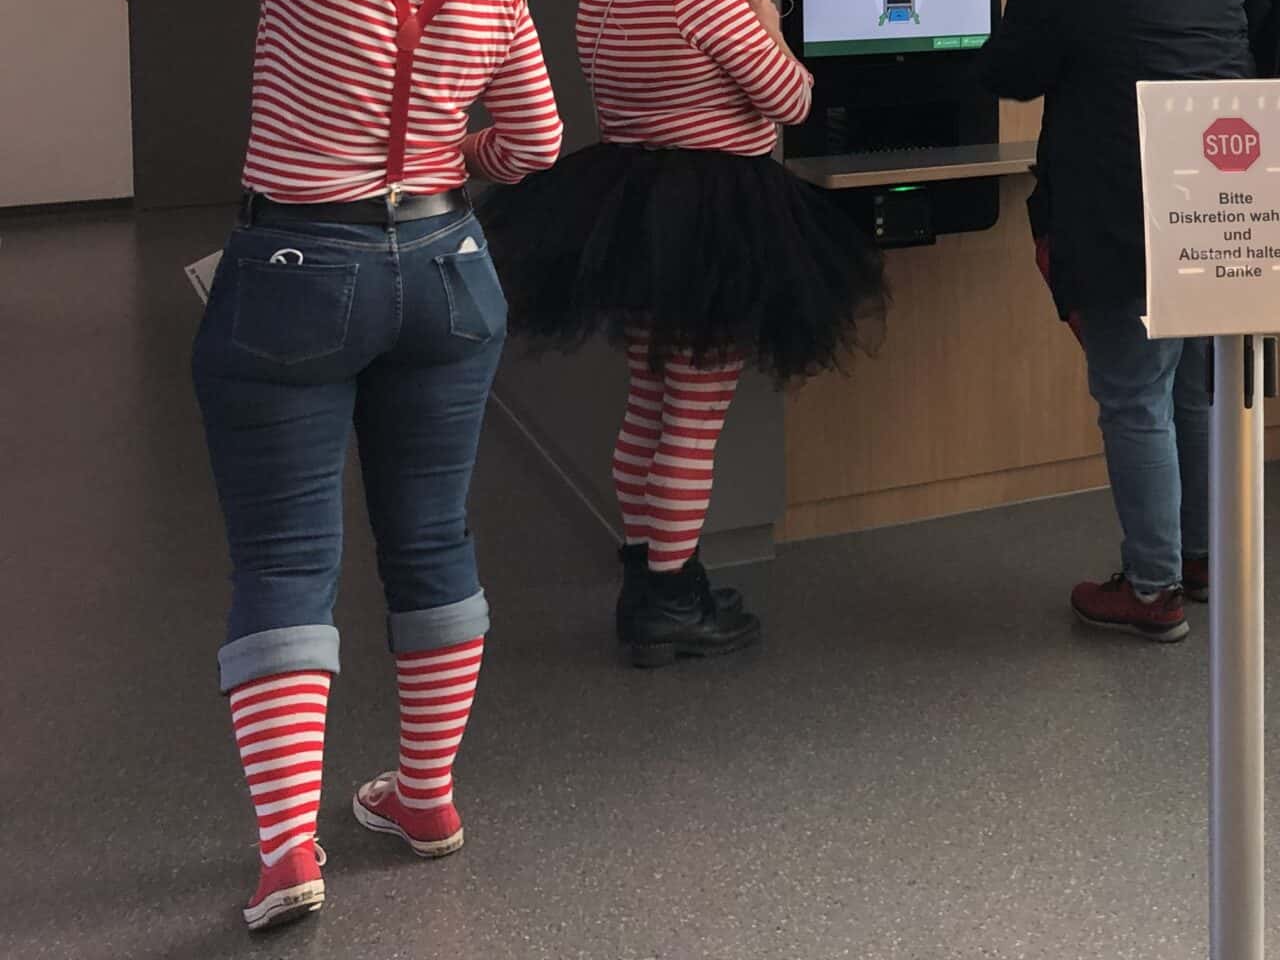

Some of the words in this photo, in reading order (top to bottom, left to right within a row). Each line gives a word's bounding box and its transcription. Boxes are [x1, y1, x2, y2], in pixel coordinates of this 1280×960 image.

[1206, 134, 1257, 155] STOP
[1218, 192, 1253, 205] Bitte
[1169, 210, 1245, 224] Diskretion
[1223, 227, 1252, 241] und
[1179, 246, 1242, 261] Abstand
[1215, 265, 1262, 278] Danke
